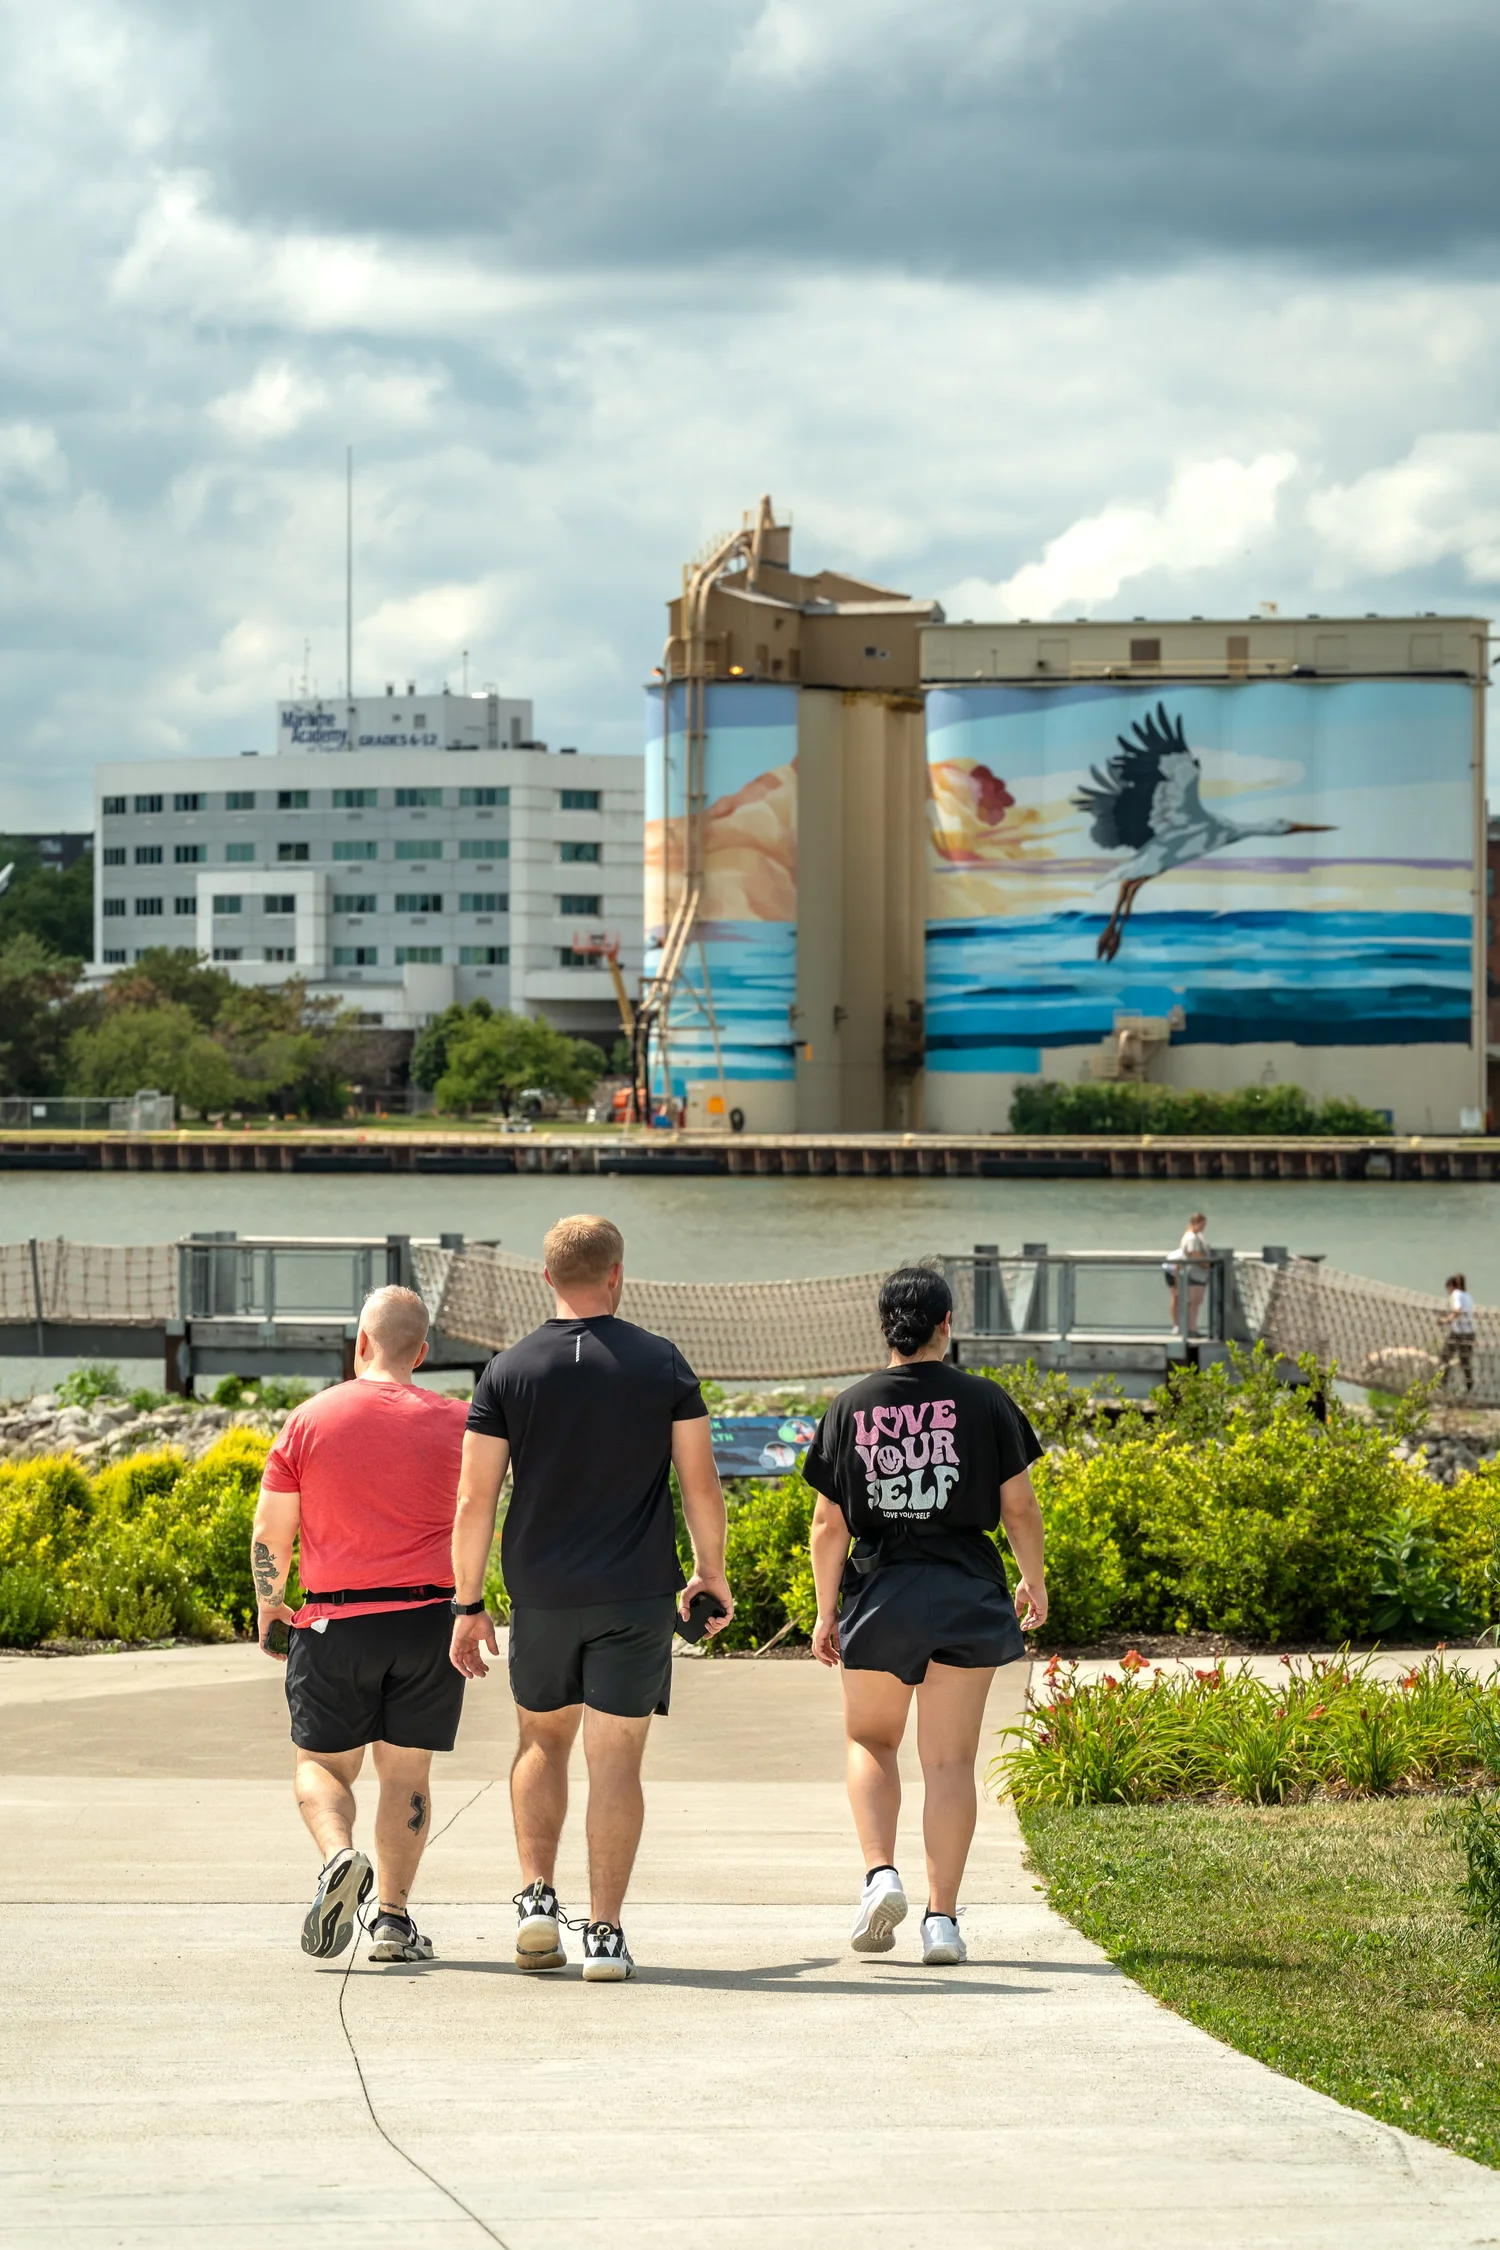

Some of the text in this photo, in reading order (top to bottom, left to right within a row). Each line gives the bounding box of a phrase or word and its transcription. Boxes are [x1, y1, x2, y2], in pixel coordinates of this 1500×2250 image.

[291, 728, 349, 748] Academy
[359, 734, 437, 746] GRADES 6-12
[853, 1399, 957, 1446] LOVE
[854, 1429, 960, 1482] YOUR
[866, 1465, 960, 1510] SELF
[883, 1510, 898, 1519] LOVE
